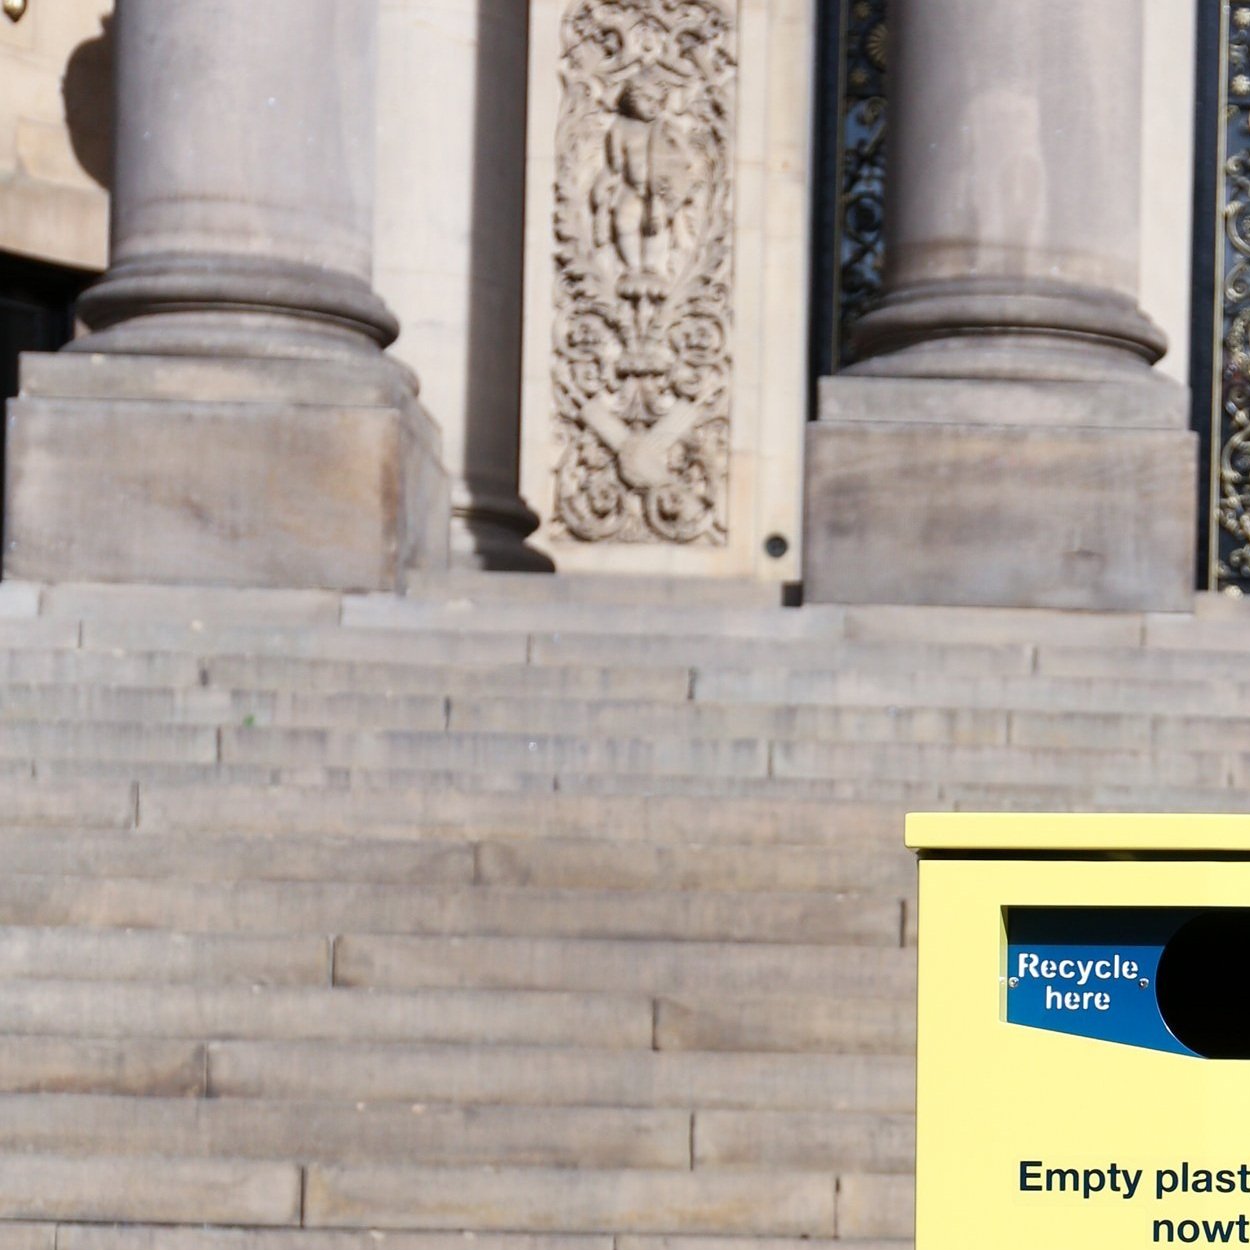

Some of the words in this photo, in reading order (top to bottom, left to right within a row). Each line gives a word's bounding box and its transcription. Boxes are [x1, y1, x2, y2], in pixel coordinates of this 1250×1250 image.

[1018, 952, 1139, 986] Recycle
[1045, 985, 1111, 1011] here
[1019, 1160, 1143, 1200] Empty
[1153, 1214, 1250, 1244] nowt
